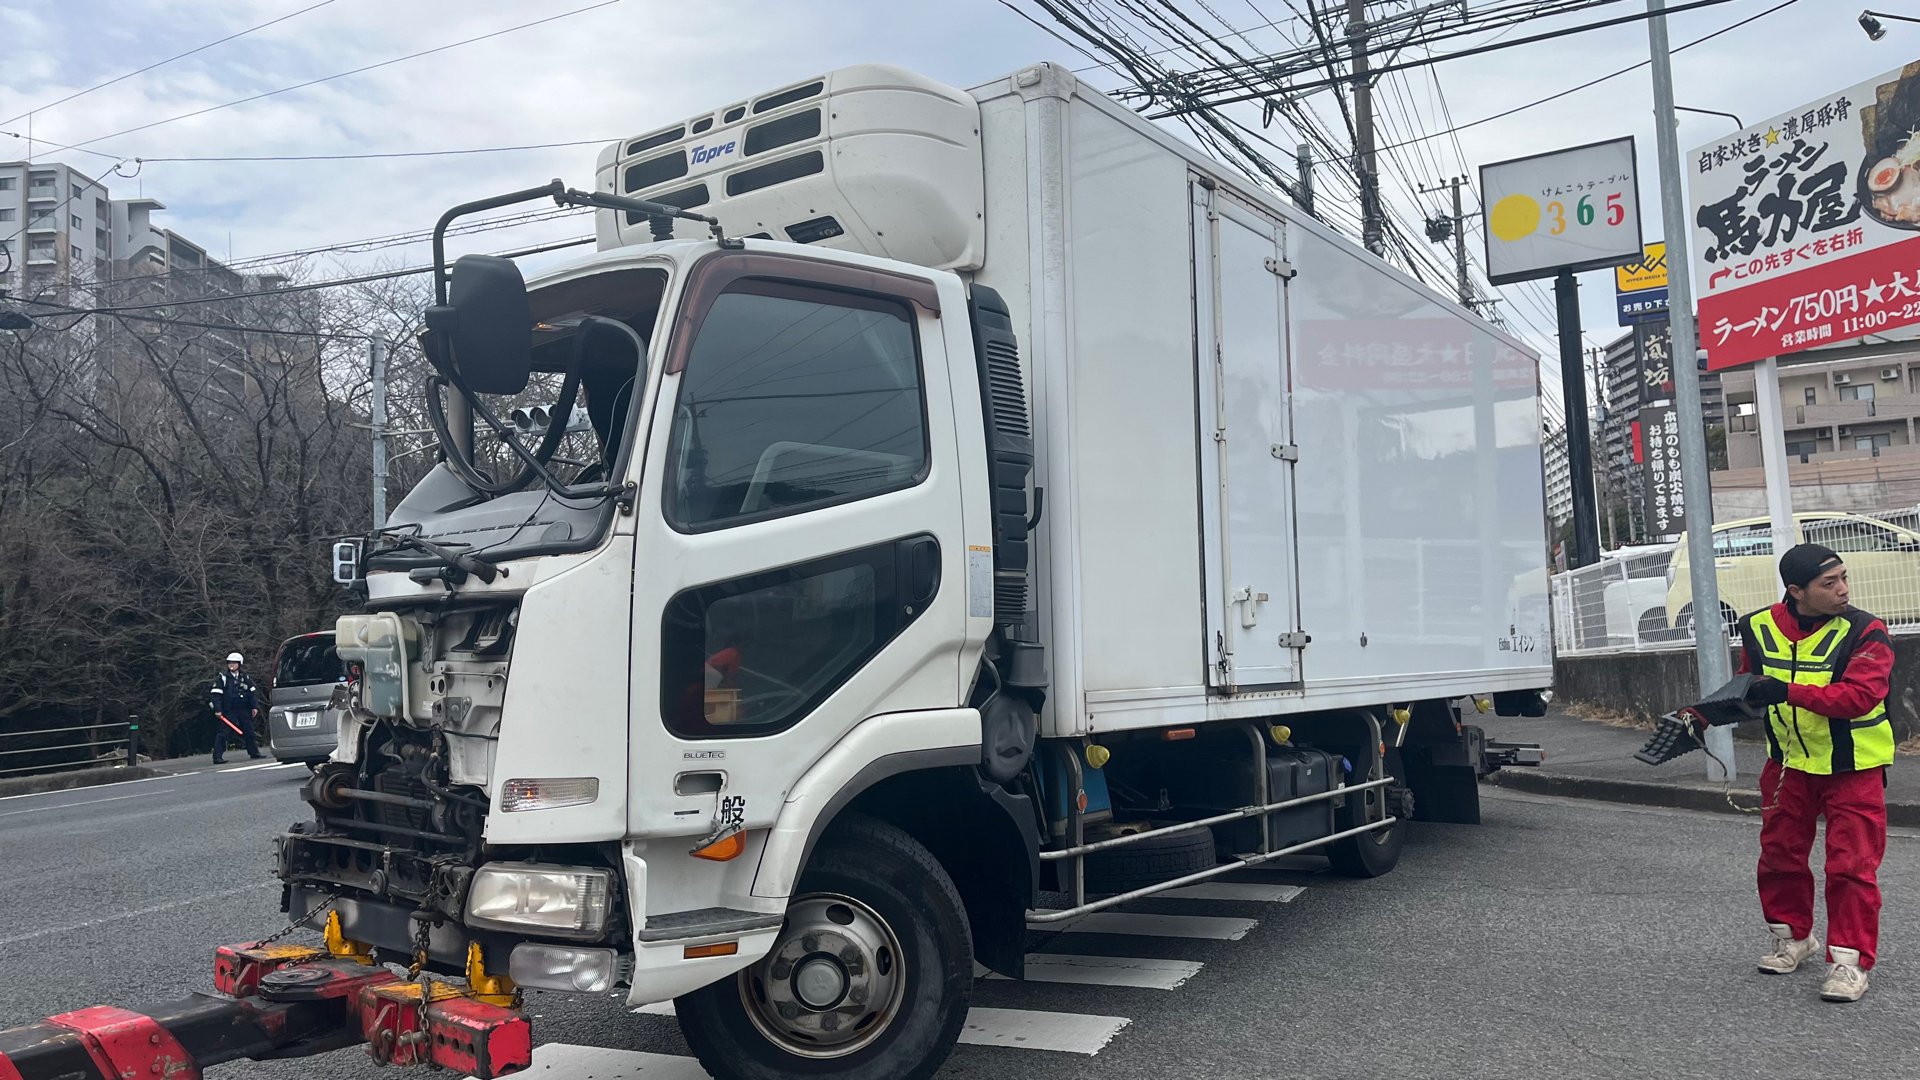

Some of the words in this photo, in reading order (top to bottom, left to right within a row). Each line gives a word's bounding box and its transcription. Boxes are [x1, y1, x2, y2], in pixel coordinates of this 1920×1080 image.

[691, 141, 736, 165] Topre
[1698, 133, 1761, 174] 自家炊き
[1782, 96, 1852, 140] 濃厚豚骨
[1542, 174, 1629, 197] けんこうテーブル
[1743, 140, 1828, 196] ラーメン
[1547, 192, 1625, 235] 365
[1697, 161, 1862, 263] 馬力屋
[1734, 227, 1863, 279] この先すぐを右折
[1887, 270, 1920, 302] 大
[1781, 323, 1832, 348] 営業時間
[1649, 425, 1669, 531] お持ち帰りできます
[1664, 411, 1684, 517] 本場のもも炭火焼き
[1512, 635, 1535, 653] エイシン
